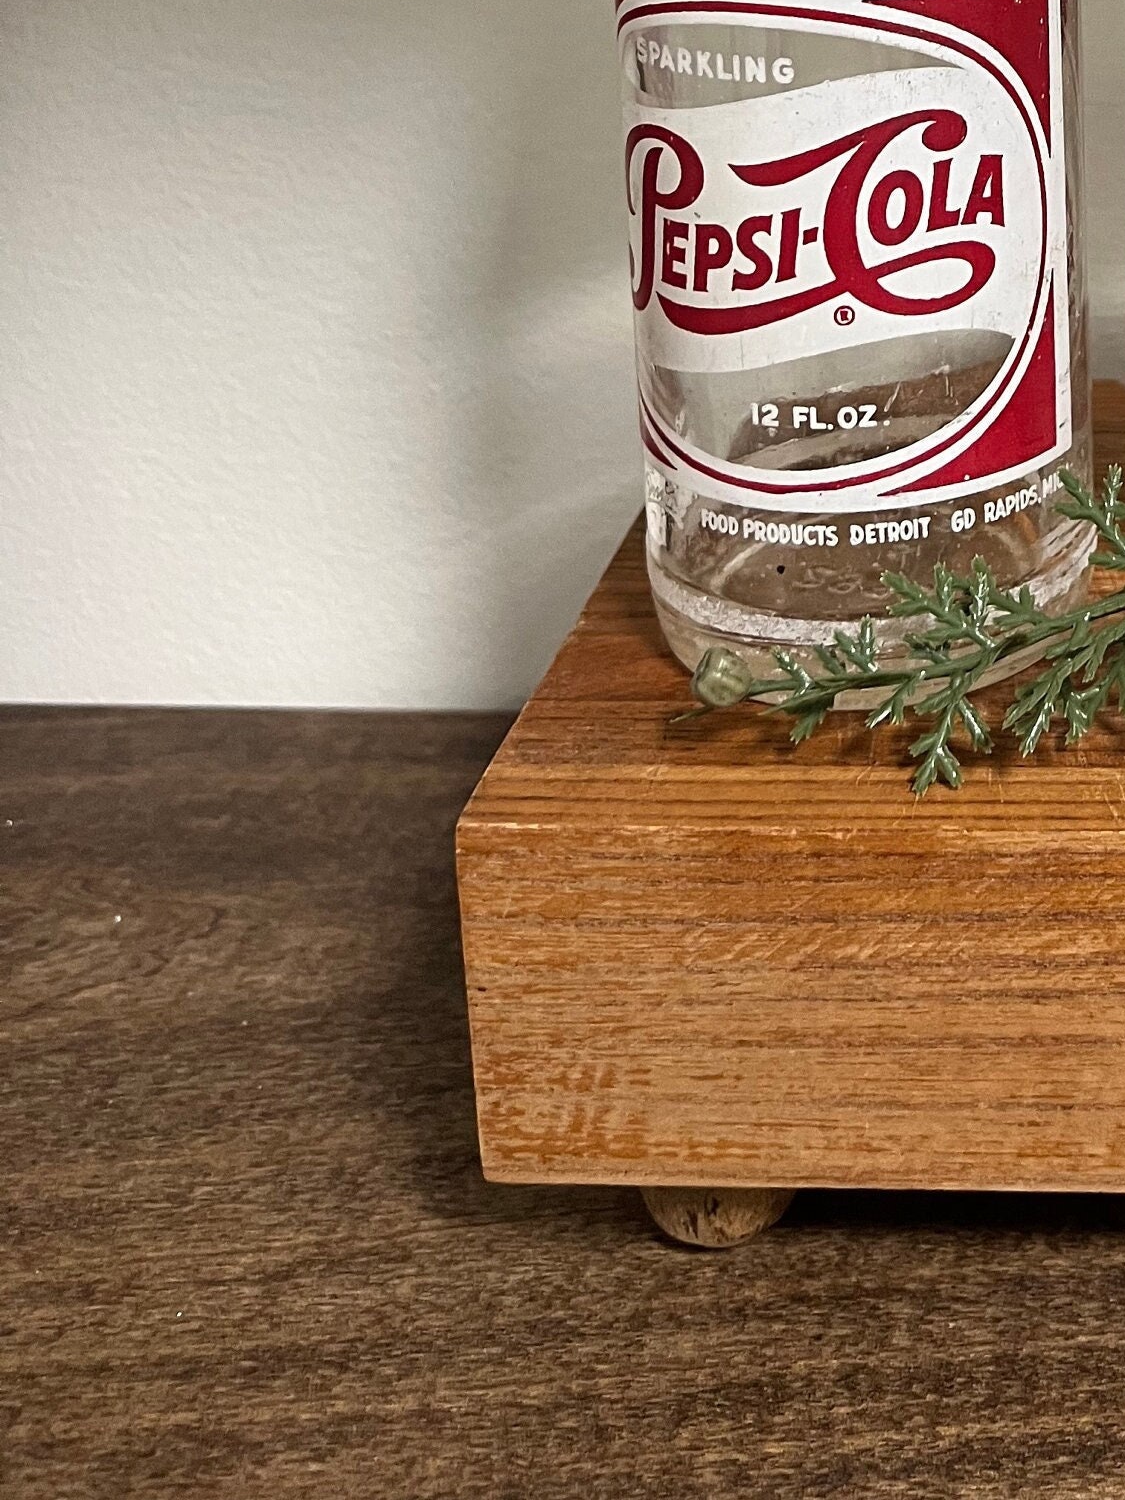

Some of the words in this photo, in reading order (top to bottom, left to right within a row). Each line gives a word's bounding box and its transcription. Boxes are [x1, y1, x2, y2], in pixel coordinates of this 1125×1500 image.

[636, 35, 795, 84] SPARKLING
[750, 402, 780, 427] 12
[701, 508, 740, 536] FOOD
[743, 522, 840, 547] PRODUCTS
[849, 517, 931, 546] DETROIT
